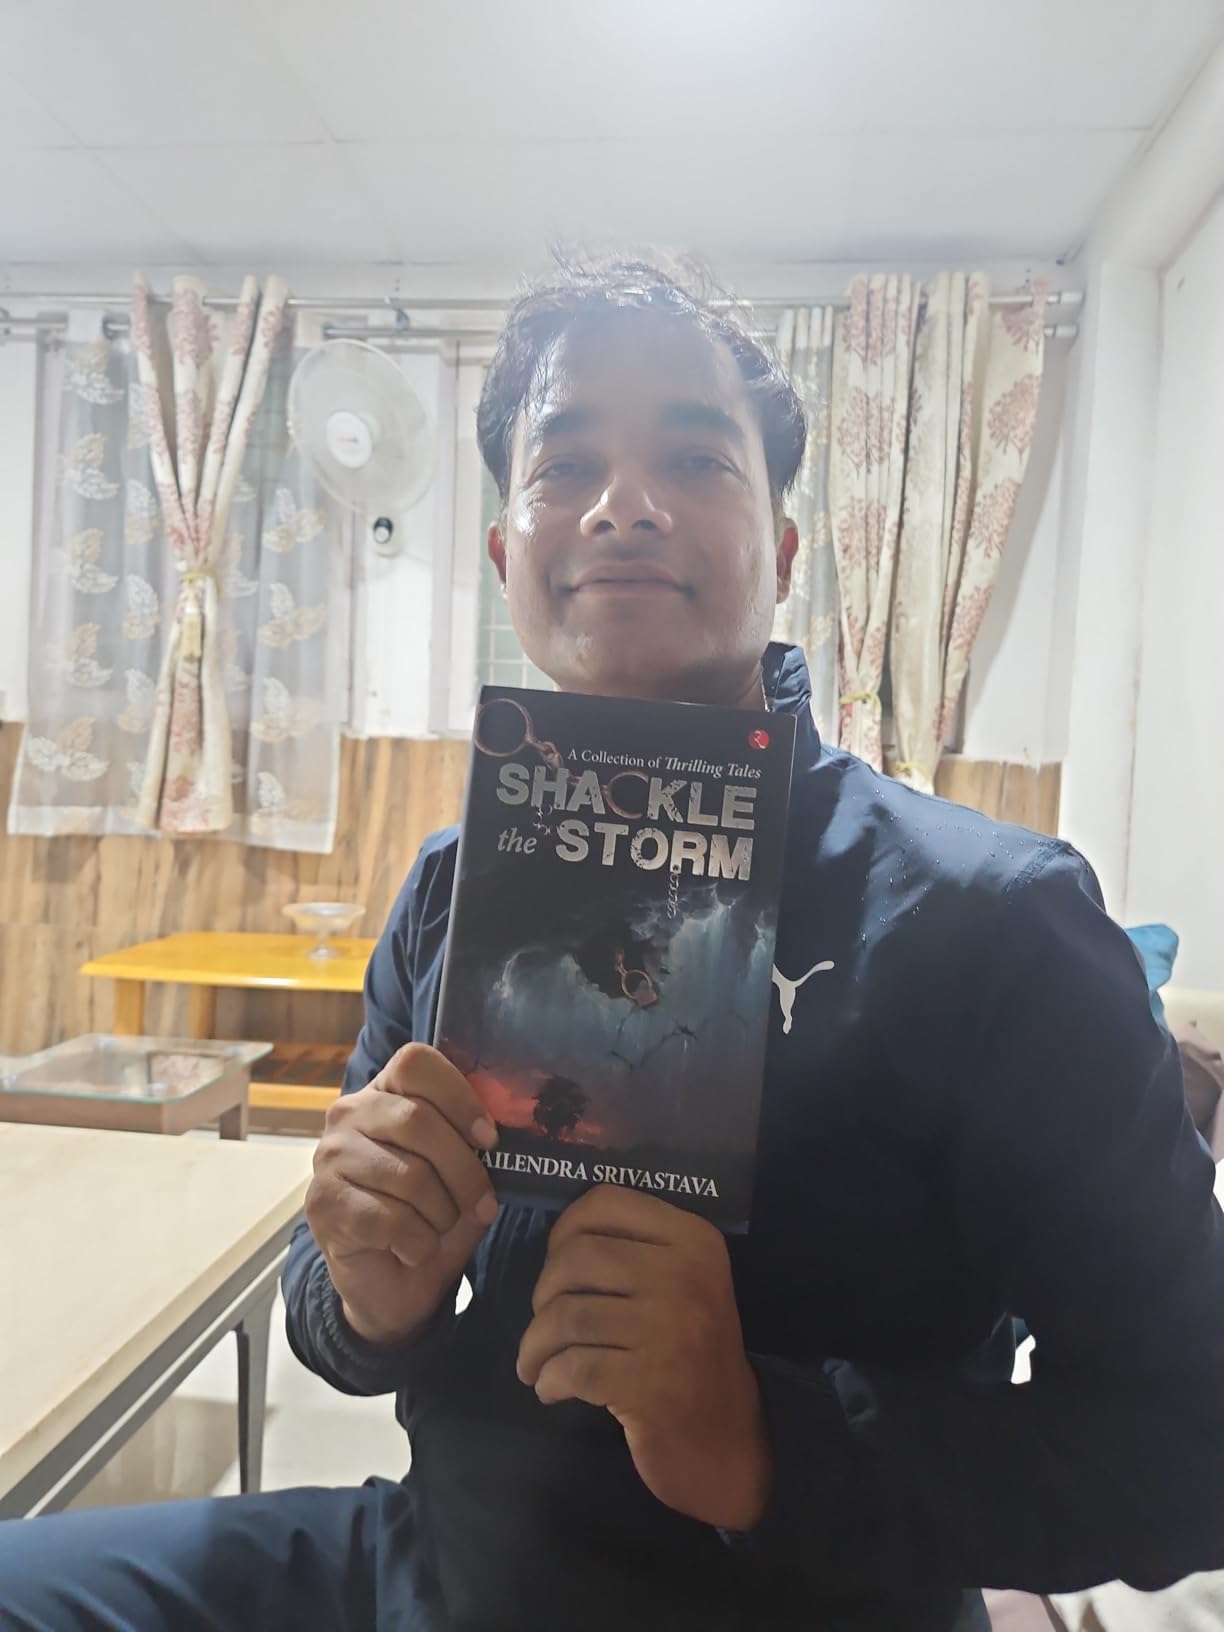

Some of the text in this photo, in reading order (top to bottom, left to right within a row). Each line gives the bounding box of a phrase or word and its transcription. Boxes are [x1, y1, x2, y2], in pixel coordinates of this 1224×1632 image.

[567, 748, 762, 779] A Collection of Thrilling Tales
[496, 763, 757, 831] SHACKLE
[497, 819, 754, 881] the STORM
[592, 1164, 719, 1198] SRIVASTAVA
